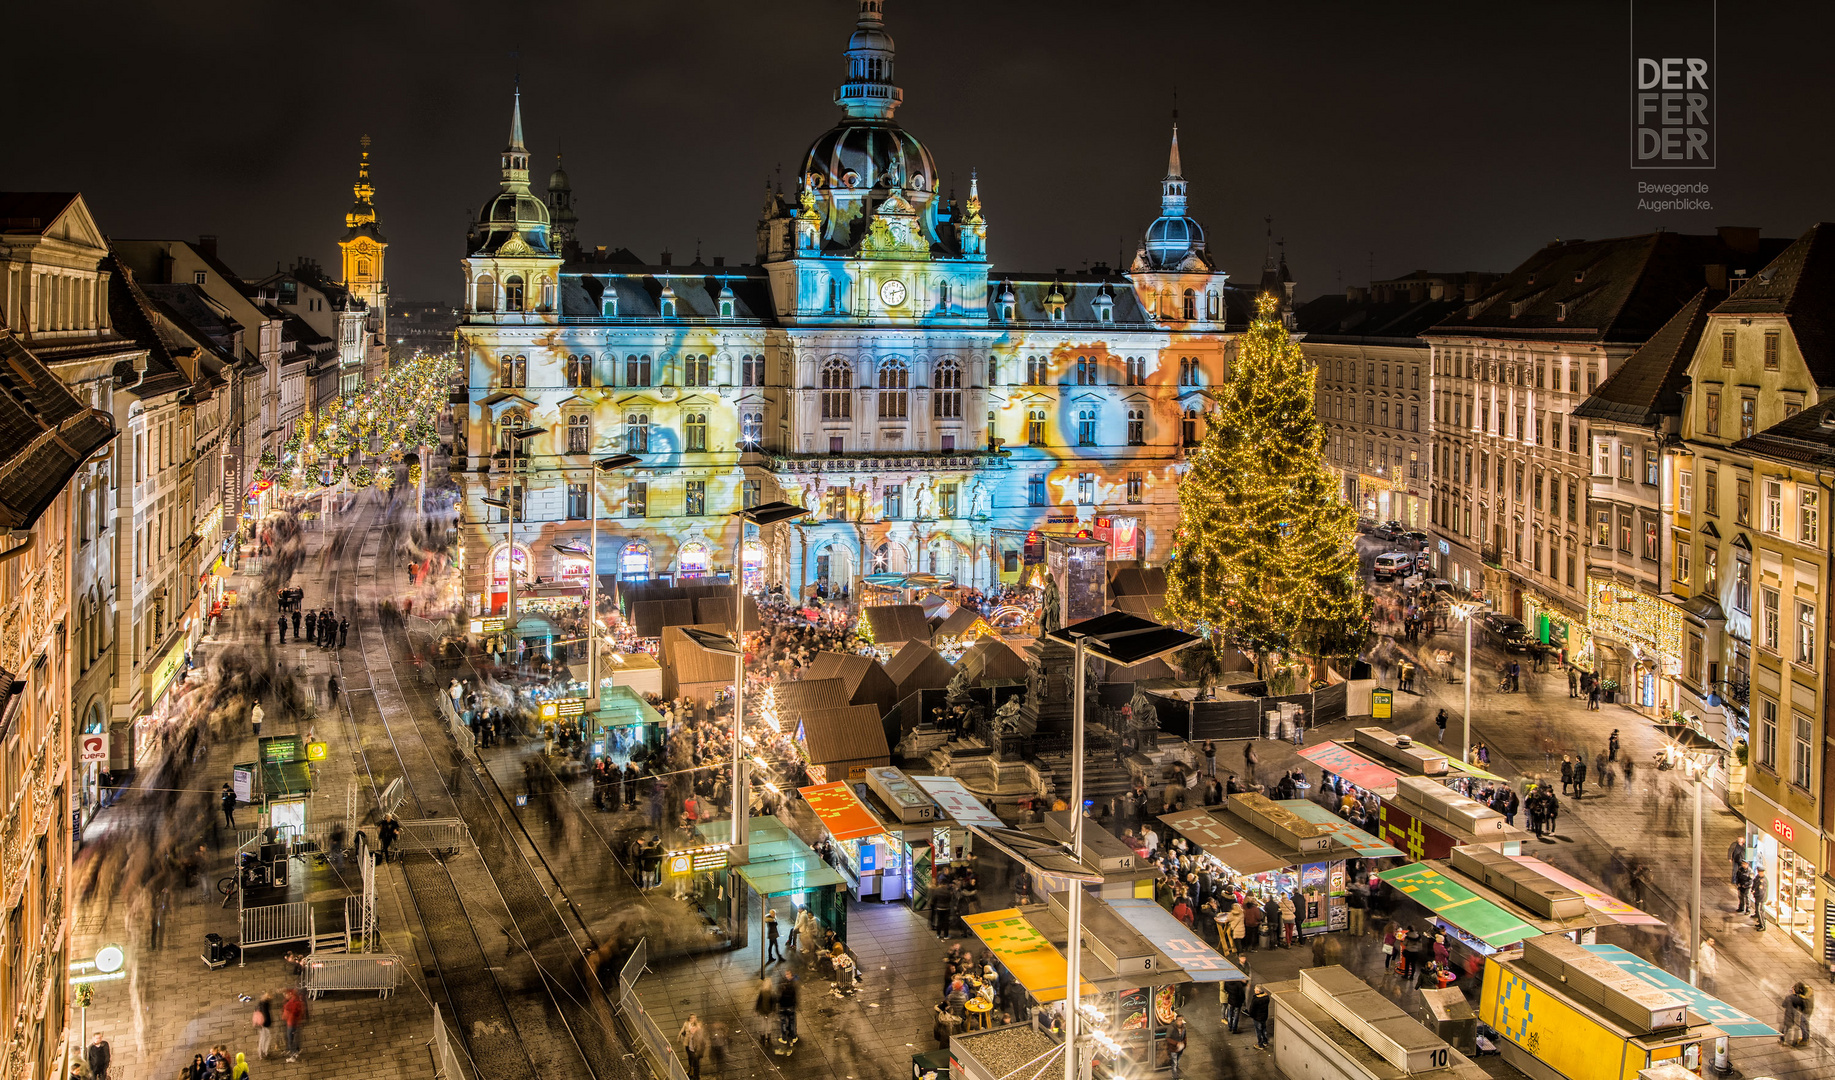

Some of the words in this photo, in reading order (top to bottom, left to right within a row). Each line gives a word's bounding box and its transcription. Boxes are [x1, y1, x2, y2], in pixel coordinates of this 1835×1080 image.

[225, 470, 235, 517] HUMANIC
[1441, 762, 1446, 770] 7
[517, 796, 526, 805] W
[919, 809, 930, 818] 15
[1496, 821, 1502, 830] 6
[1774, 818, 1793, 841] ara
[1317, 839, 1327, 849] 12
[1118, 858, 1130, 868] 14
[1144, 959, 1151, 969] 8
[1676, 1011, 1682, 1022] 4
[1430, 1049, 1448, 1067] 10
